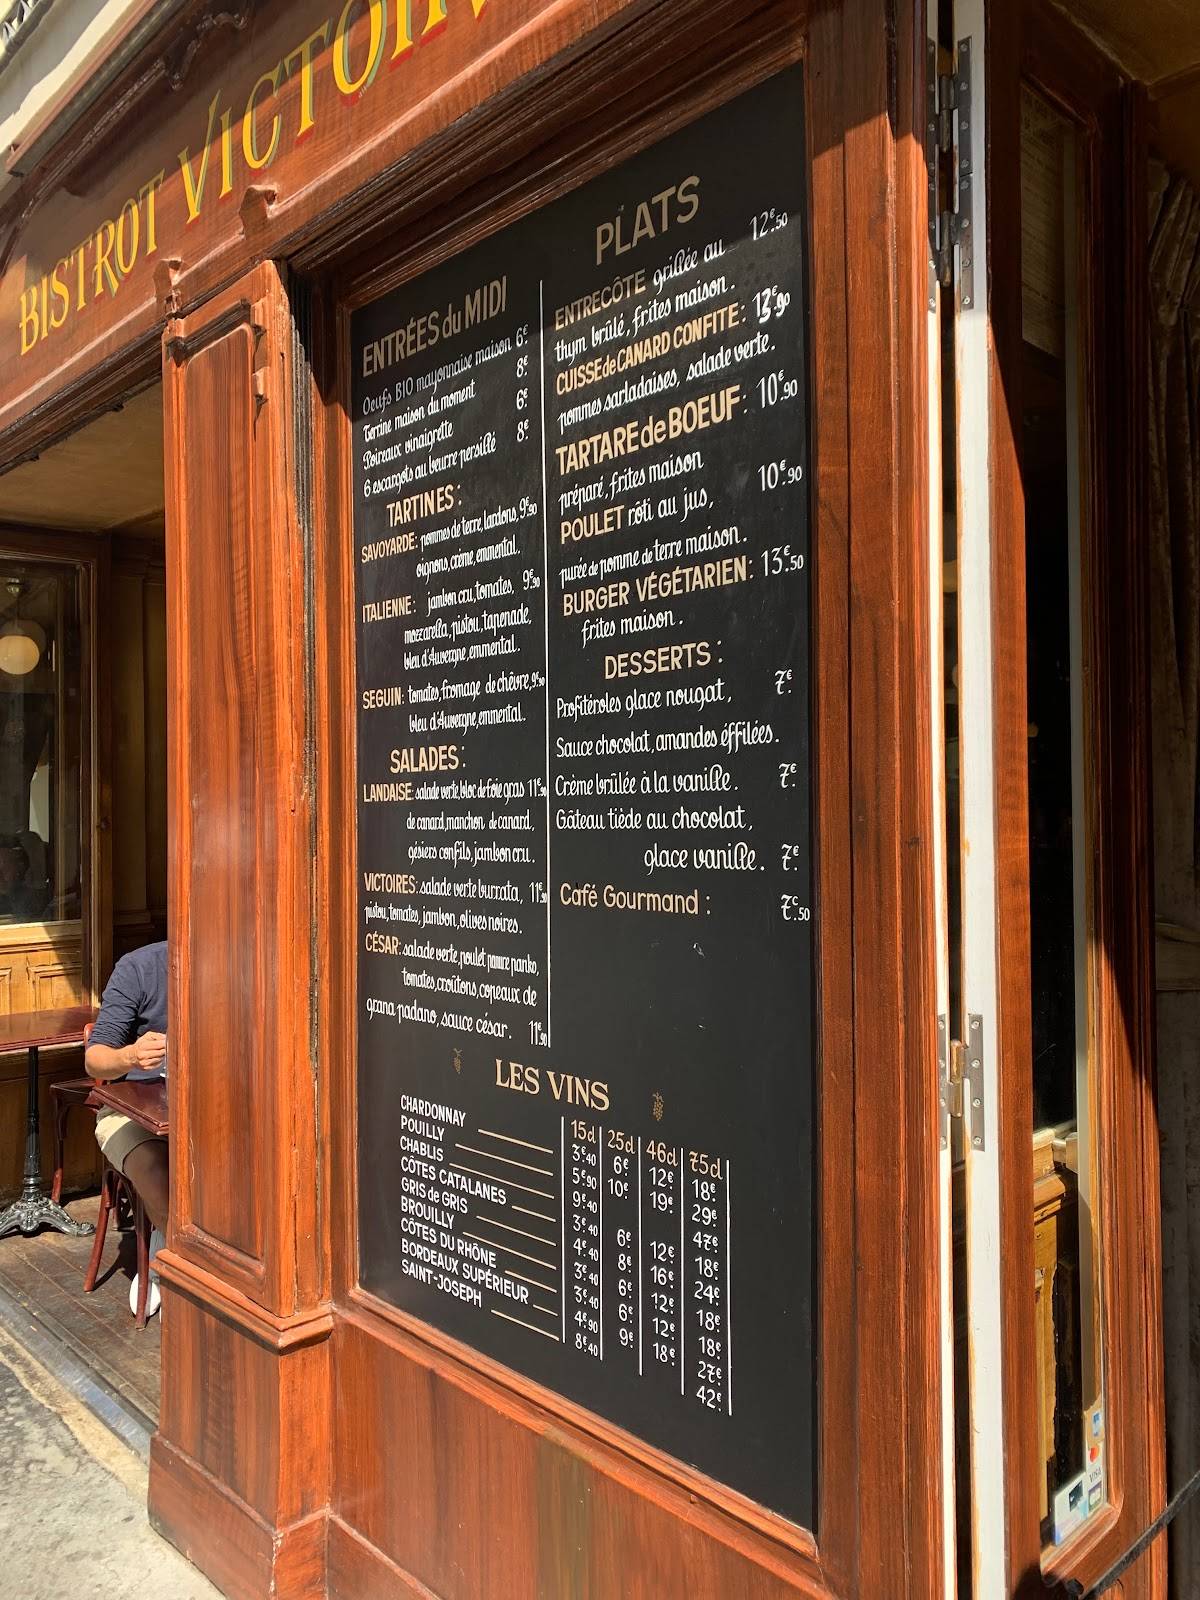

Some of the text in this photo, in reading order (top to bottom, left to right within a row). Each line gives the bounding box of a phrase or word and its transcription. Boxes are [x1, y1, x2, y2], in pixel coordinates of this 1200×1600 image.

[595, 175, 700, 266] PLATS
[19, 169, 164, 356] BISTROT
[555, 269, 646, 331] ENTRECÔTE
[653, 247, 698, 295] grillée
[704, 238, 726, 263] au
[363, 275, 506, 377] ENTRÉES du MIDI
[554, 274, 735, 366] thym brûlé, frites maison.
[363, 336, 512, 415] Oeufs BIO mayonnaise maison
[557, 357, 600, 396] CUISSE
[602, 354, 616, 376] de
[616, 332, 670, 370] CANARD
[557, 332, 775, 435] pommes sarladaises, salade verte.
[363, 421, 391, 442] Terrine
[395, 406, 425, 428] maison
[441, 382, 476, 410] moment
[363, 420, 453, 470] Poireaux vinaigrette
[556, 420, 639, 476] TARTARE
[640, 416, 666, 448] de
[364, 431, 497, 497] 6 escargots au beurre persillé
[559, 451, 704, 515] préparé, frites maison
[561, 504, 624, 544] POULET
[628, 500, 653, 527] rôti
[658, 495, 677, 516] au
[680, 486, 714, 523] jus,
[420, 530, 450, 552] pommes
[559, 525, 747, 589] purée de pomme de terre maison.
[427, 588, 457, 616] jambon
[563, 581, 630, 616] BURGER
[482, 603, 531, 638] tapenade,
[582, 609, 683, 648] frites maison.
[404, 652, 420, 670] bleu
[441, 679, 480, 702] fromage
[557, 678, 731, 722] Profitéroles glace nougat,
[409, 714, 427, 732] bleu
[556, 737, 593, 757] Sauce
[596, 730, 655, 754] chocolat,
[656, 725, 718, 751] amandes
[415, 781, 440, 800] salade
[555, 764, 738, 796] Crème brûlée à la vanille.
[447, 811, 485, 830] manchon
[498, 809, 535, 832] canard,
[556, 805, 753, 831] Gâteau tiède au chocolat,
[408, 841, 511, 867] gésiers jambon
[644, 842, 688, 875] glace
[694, 842, 765, 871] vanille.
[420, 877, 451, 896] salade
[454, 880, 477, 898] verte
[560, 883, 598, 908] Café
[459, 910, 487, 928] olives
[402, 939, 434, 960] salade
[460, 948, 486, 969] poulet
[479, 982, 521, 1004] copeaux
[523, 986, 537, 1006] de
[367, 997, 396, 1020] grana
[441, 1013, 473, 1032] sauce
[496, 1059, 610, 1111] LES VINS
[400, 1095, 466, 1127] CHARDONNAY
[401, 1115, 444, 1142] POUILLY
[400, 1136, 443, 1162] CHABLIS
[401, 1156, 507, 1205] CÔTES CATALANES
[402, 1177, 468, 1214] GRIS de GRIS
[401, 1196, 454, 1230] BROUILLY
[401, 1218, 496, 1268] CÔTES DU RHÔNE
[402, 1238, 528, 1304] BORDEAUX SUPÉRIEUR
[402, 1259, 482, 1308] SAINT-JOSEPH
